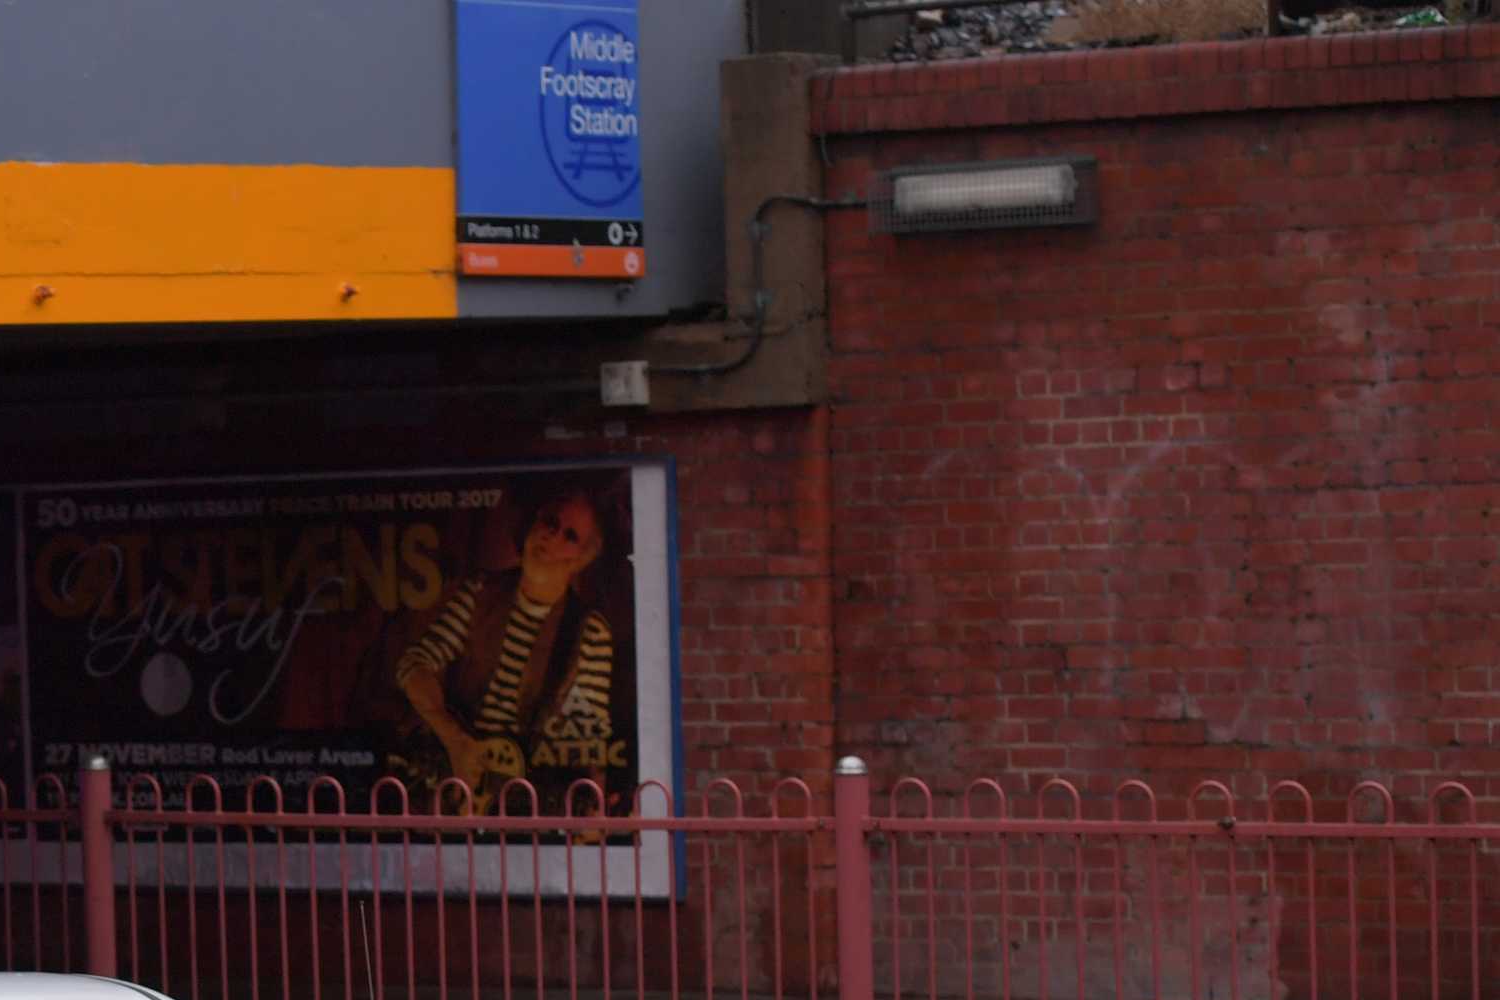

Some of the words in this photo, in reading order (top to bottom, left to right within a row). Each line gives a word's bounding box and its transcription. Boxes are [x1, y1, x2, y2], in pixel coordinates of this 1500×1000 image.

[569, 31, 635, 63] Middle
[540, 65, 636, 106] Footscray
[570, 102, 638, 136] Station
[37, 498, 78, 528] 50
[82, 504, 129, 522] YEAR
[336, 492, 394, 512] TRAIN
[399, 491, 454, 511] TOUR
[456, 488, 502, 510] 2017
[44, 743, 73, 765] 27
[221, 746, 259, 764] Rod
[262, 746, 314, 765] Laver
[318, 747, 376, 766] Arena
[531, 740, 628, 768] ATTIC
